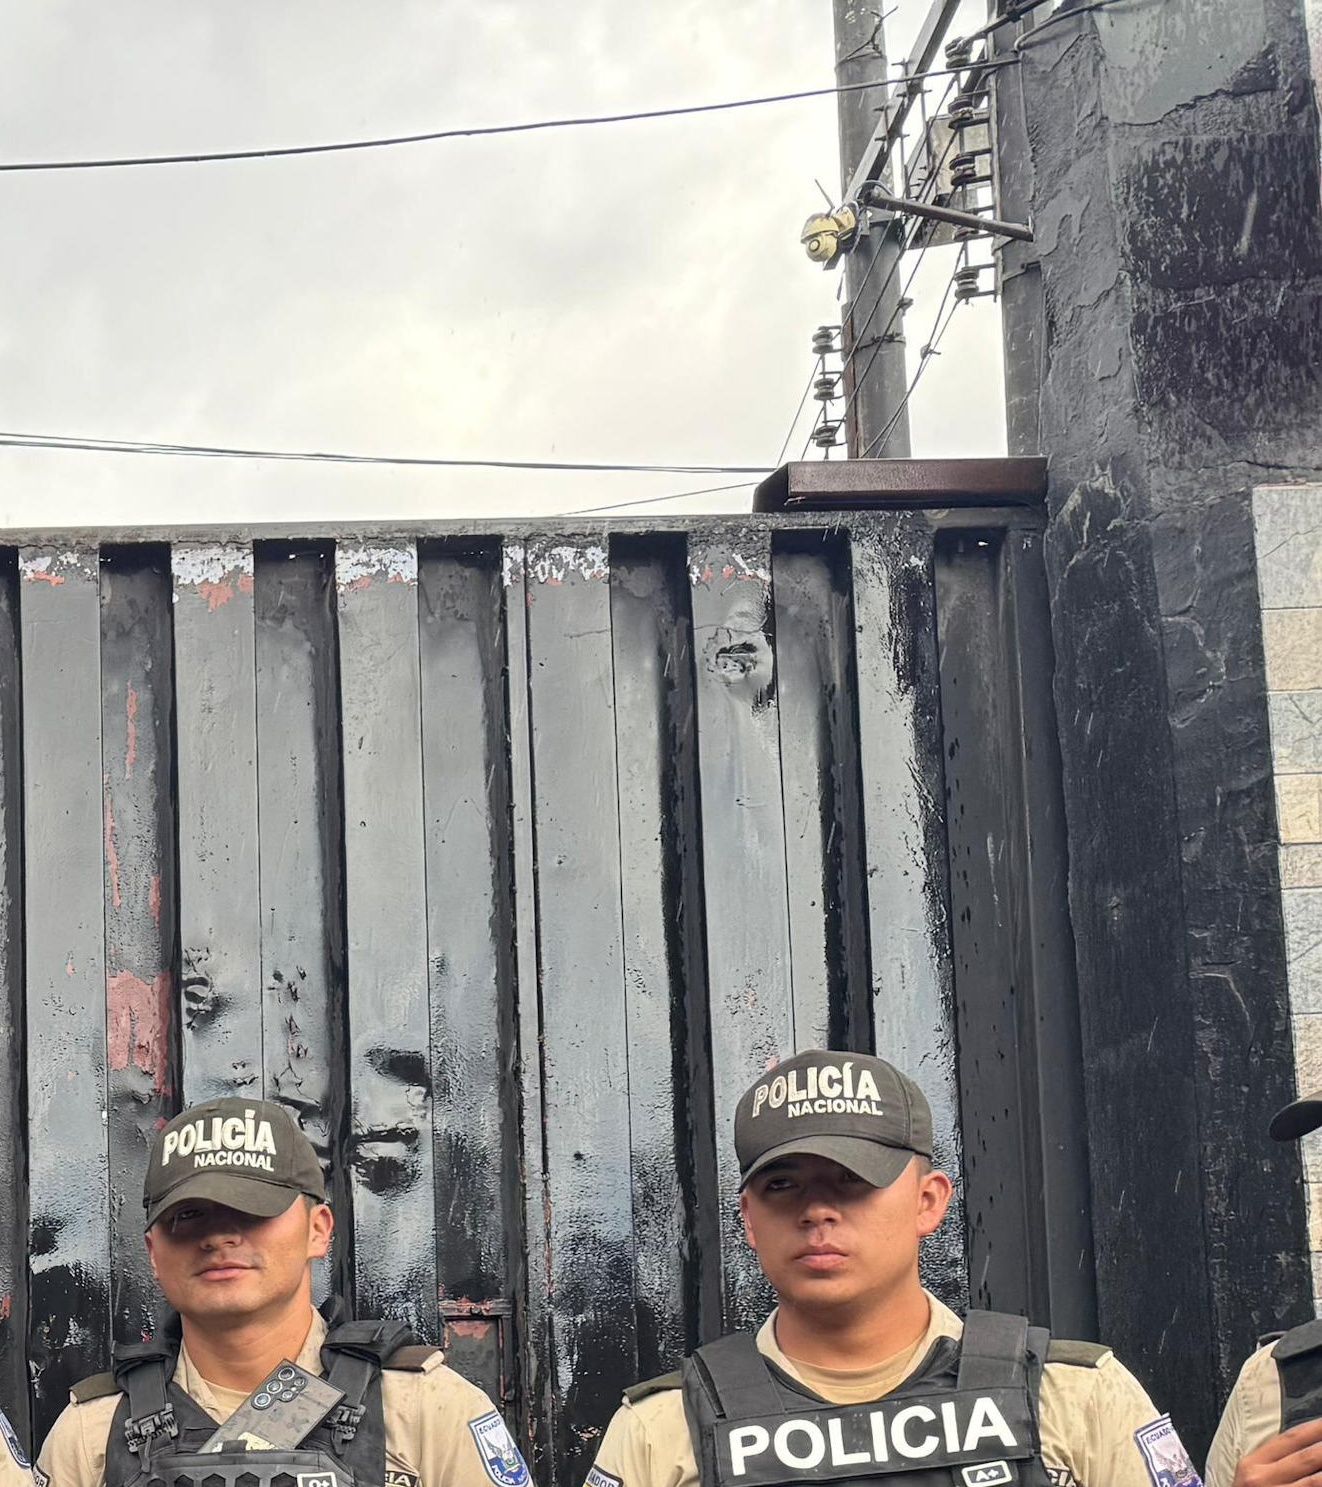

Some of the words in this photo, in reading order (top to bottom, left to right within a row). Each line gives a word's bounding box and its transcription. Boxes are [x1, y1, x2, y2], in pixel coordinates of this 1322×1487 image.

[752, 1062, 882, 1118] POLICÍA
[787, 1099, 884, 1118] NACIONAL
[162, 1109, 277, 1166] POLICÍA
[193, 1151, 275, 1172] NACIONAL
[729, 1397, 1018, 1476] POLICIA
